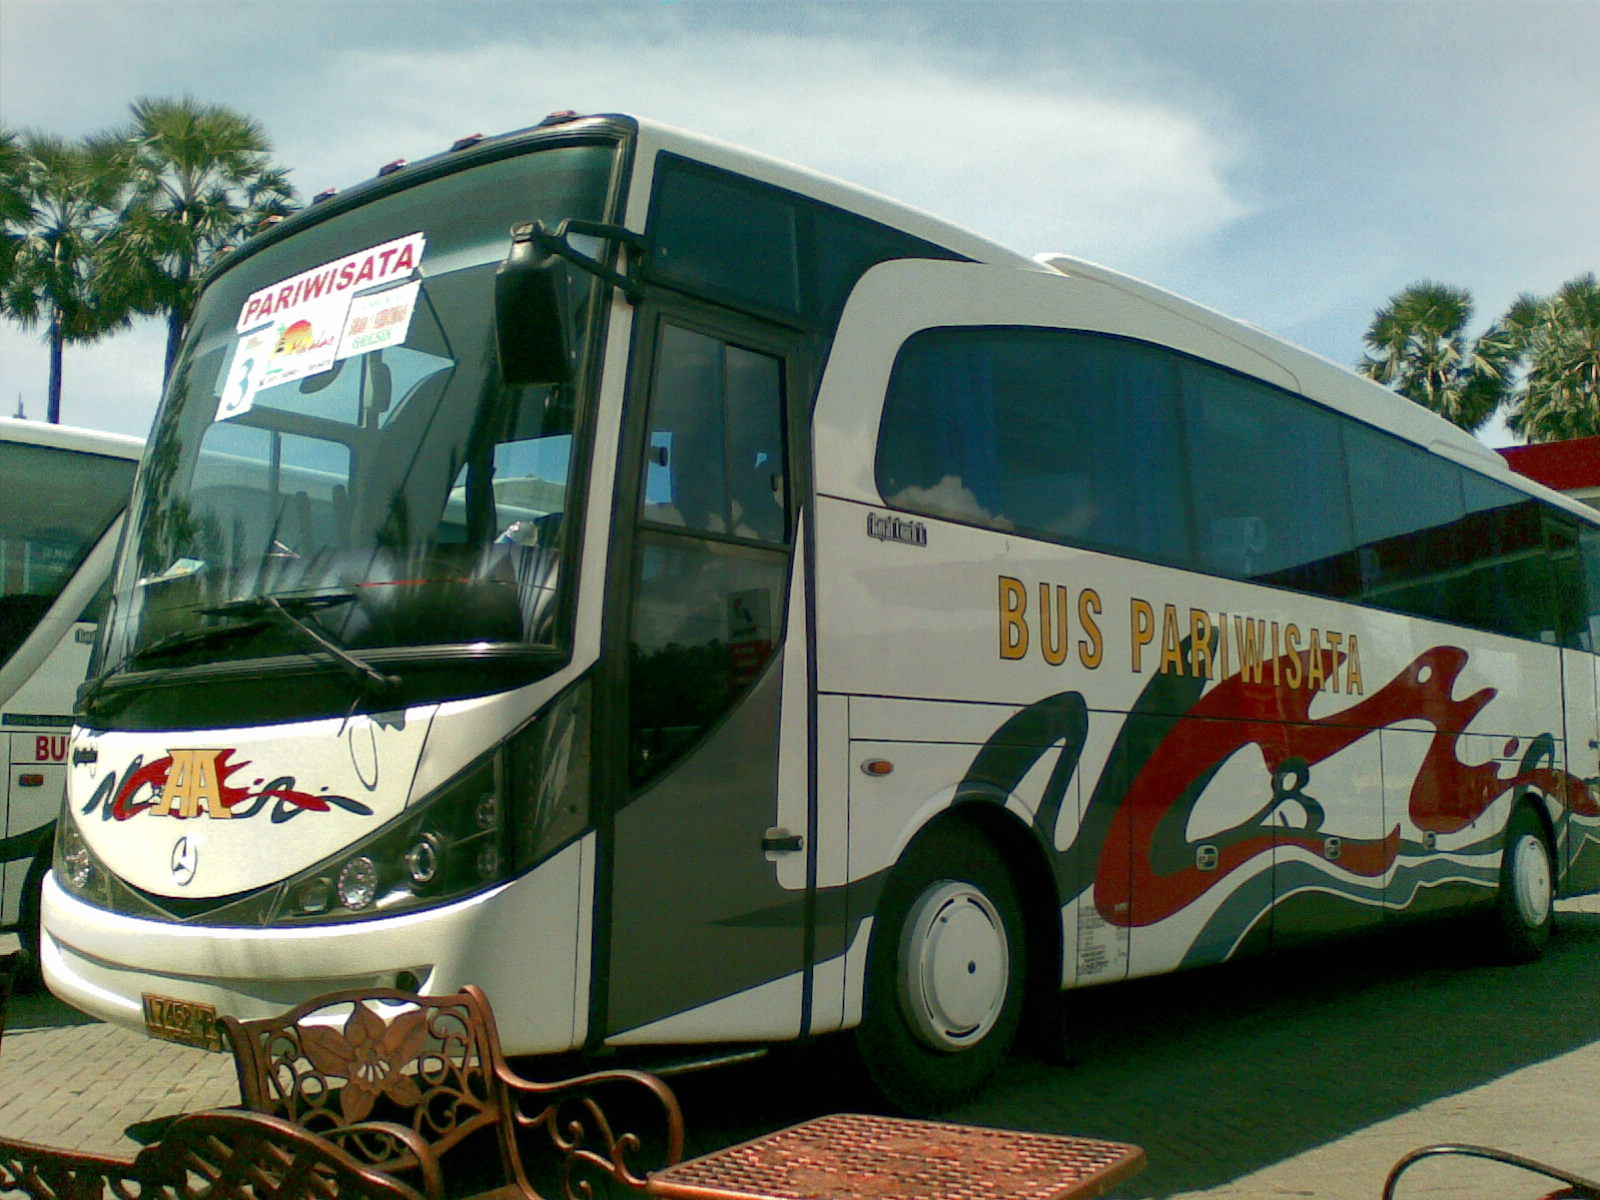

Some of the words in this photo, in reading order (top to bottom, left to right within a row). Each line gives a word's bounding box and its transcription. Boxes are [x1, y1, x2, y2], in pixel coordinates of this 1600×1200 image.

[242, 243, 414, 326] PARIWISATA
[226, 357, 255, 412] 3
[998, 575, 1104, 670] BUS
[1130, 597, 1364, 696] PARIWISATA
[36, 735, 69, 761] BU
